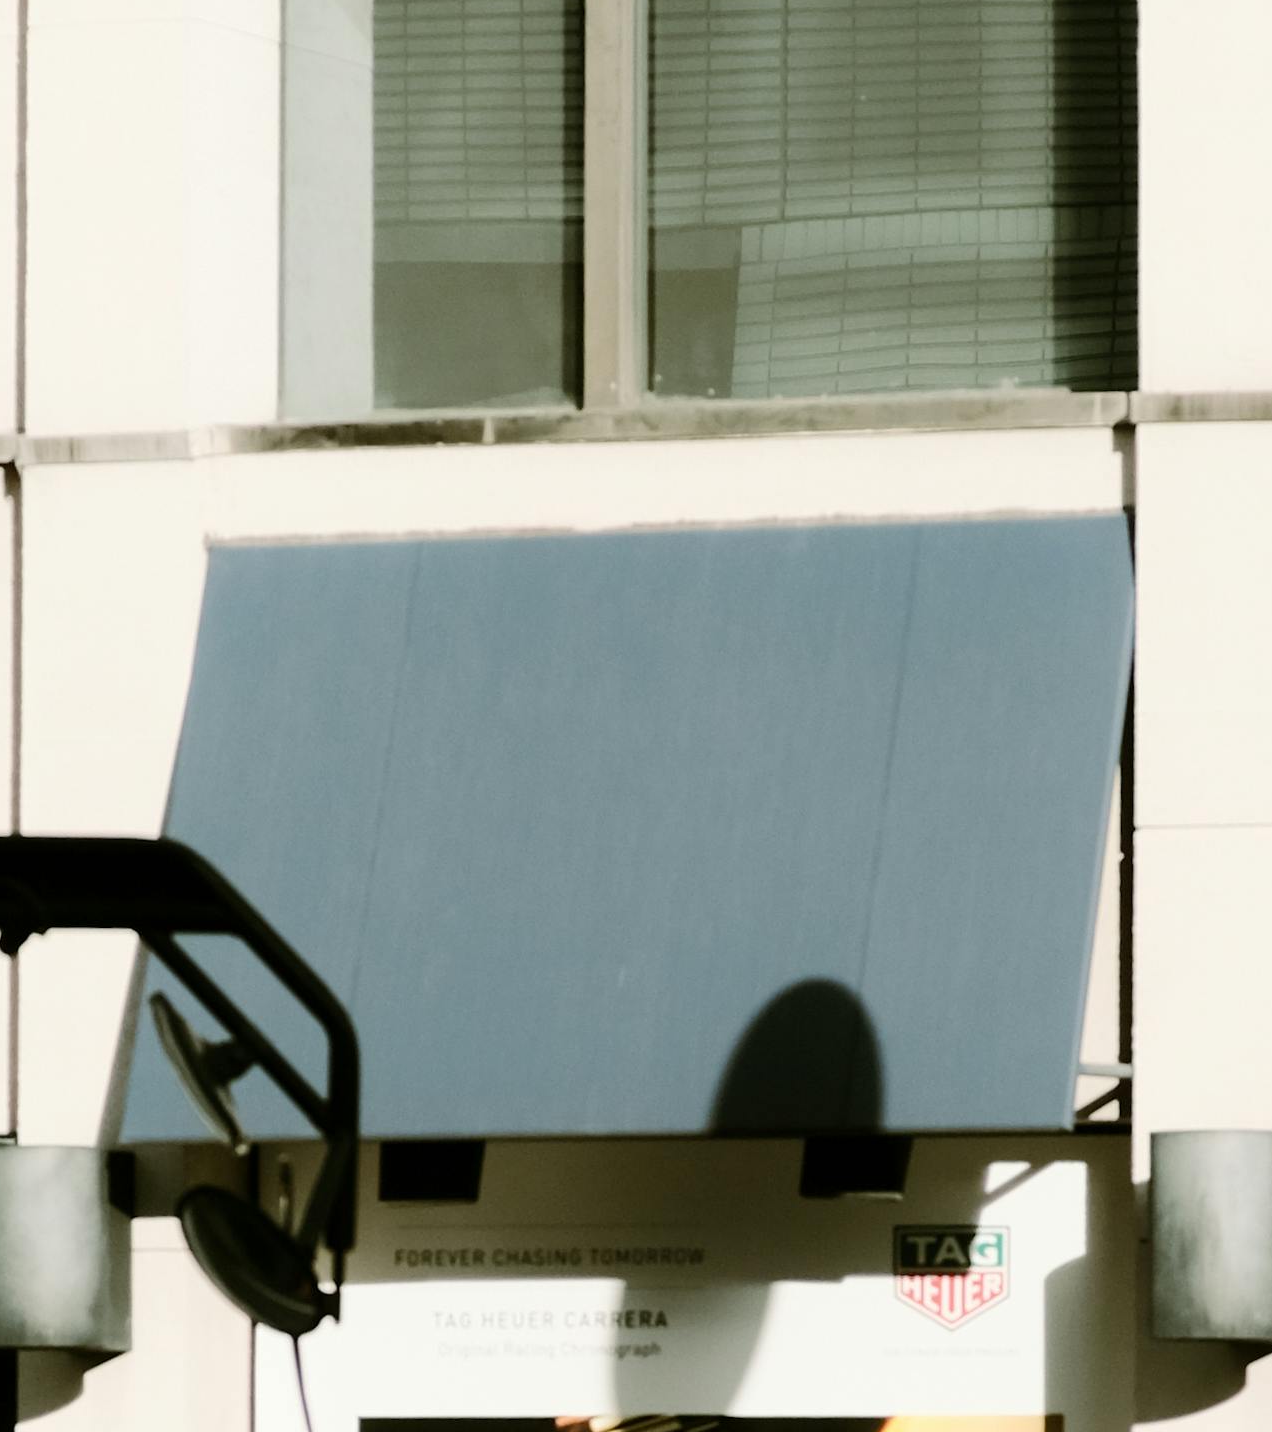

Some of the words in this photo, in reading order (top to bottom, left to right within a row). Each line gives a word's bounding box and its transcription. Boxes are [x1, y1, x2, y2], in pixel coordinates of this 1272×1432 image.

[393, 1248, 485, 1267] FOREVER
[491, 1247, 582, 1266] CHASING
[589, 1246, 705, 1266] TOMORROW
[905, 1233, 1000, 1267] TAG
[901, 1270, 1003, 1322] HEUER
[431, 1310, 472, 1329] TAG
[480, 1310, 555, 1329] HEUER
[563, 1309, 669, 1329] CARRERA
